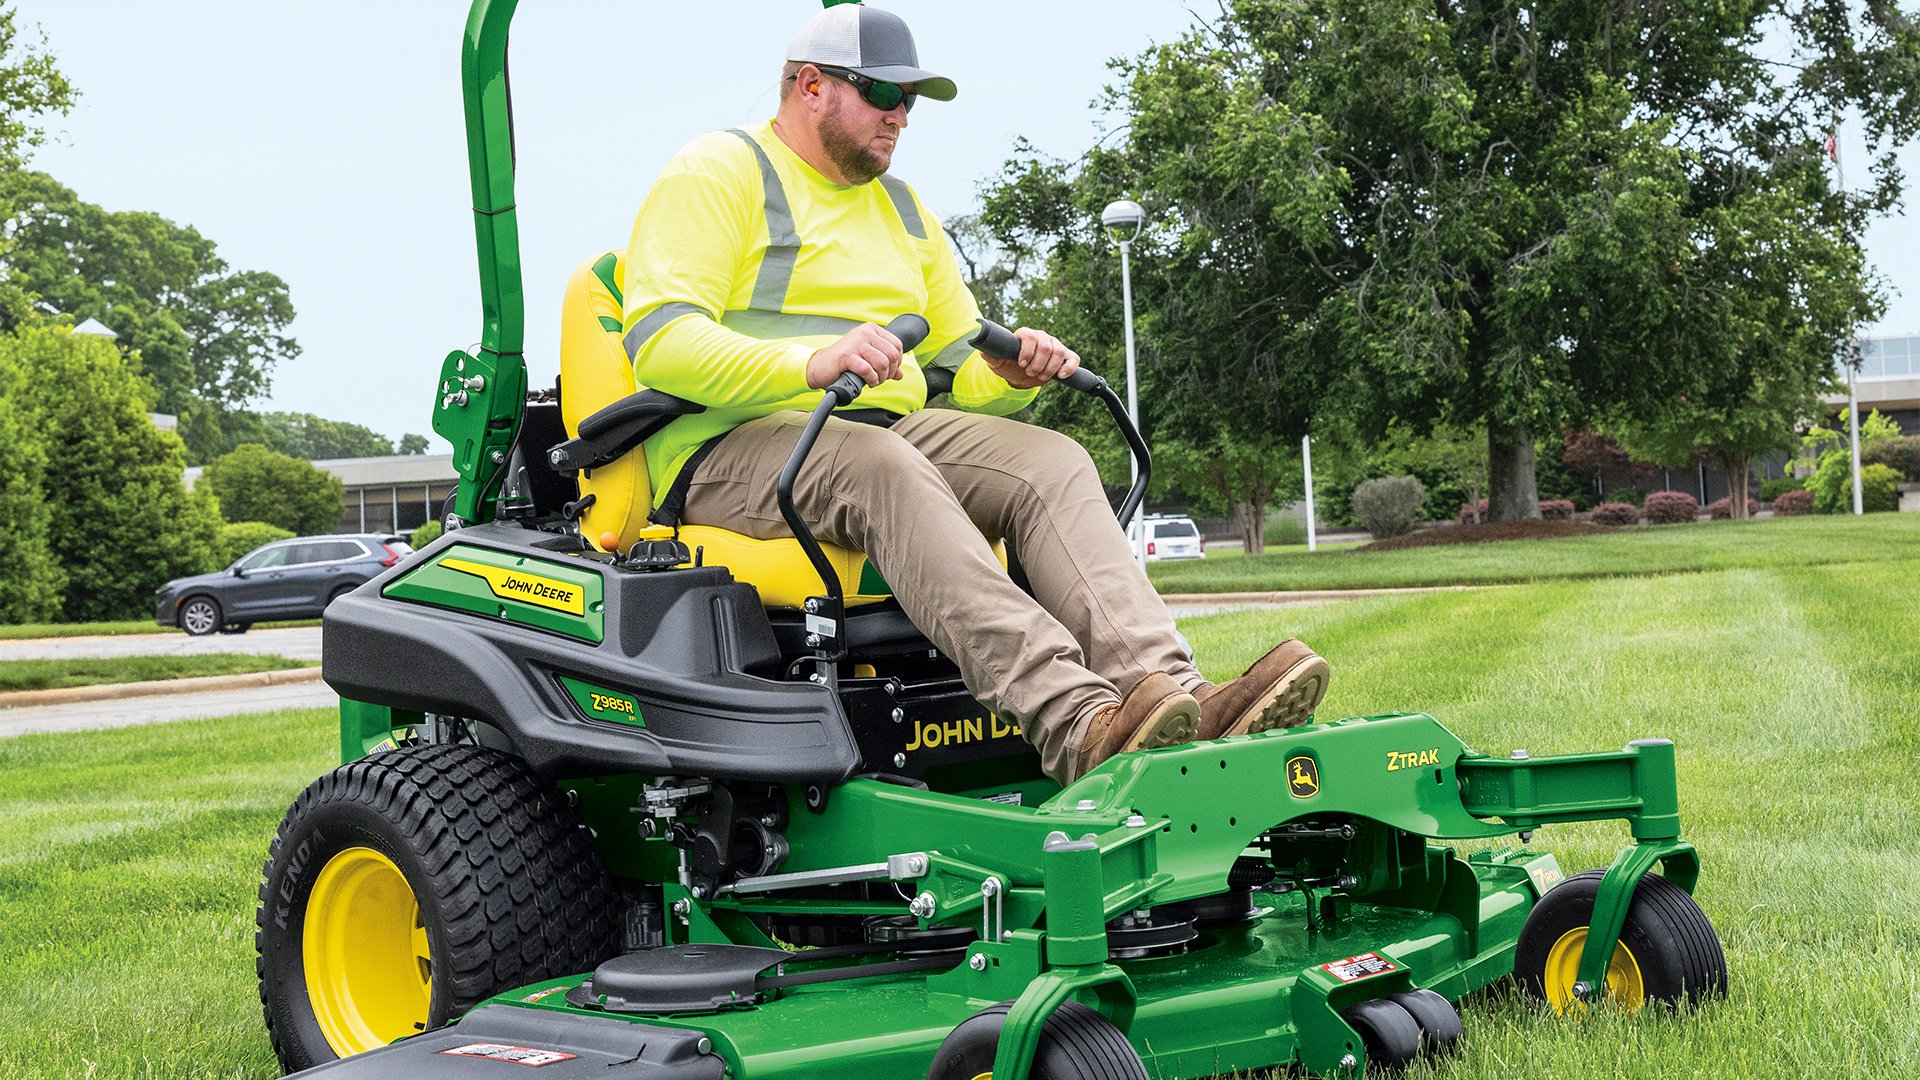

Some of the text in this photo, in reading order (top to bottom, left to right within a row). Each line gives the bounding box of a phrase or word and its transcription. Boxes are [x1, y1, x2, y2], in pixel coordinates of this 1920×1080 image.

[501, 576, 574, 603] JOHN DEERE
[590, 693, 635, 714] Z985R
[906, 717, 983, 751] JOHN
[1386, 747, 1440, 772] ZTRAK
[274, 828, 327, 931] KENDA
